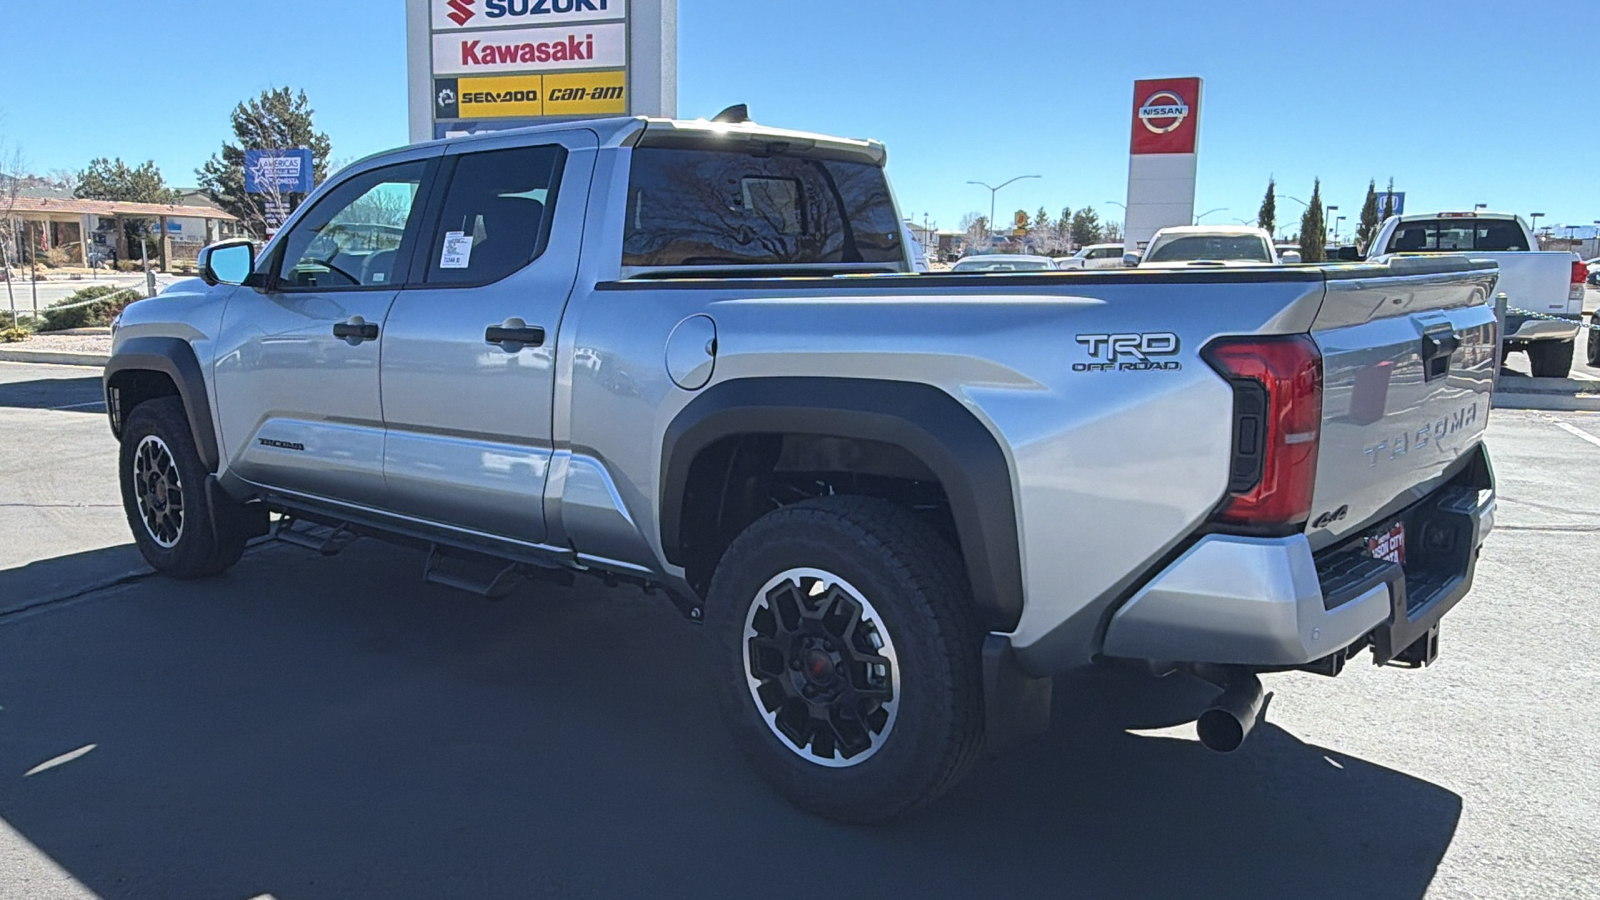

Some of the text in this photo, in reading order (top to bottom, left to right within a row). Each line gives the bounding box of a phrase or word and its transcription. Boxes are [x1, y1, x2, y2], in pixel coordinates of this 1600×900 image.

[461, 33, 593, 66] Kawasaki
[549, 86, 624, 101] can-am
[1143, 107, 1183, 116] NISSAN
[1075, 331, 1181, 363] TRD
[1072, 361, 1182, 372] OFF ROAD
[1364, 402, 1477, 468] TACOMA
